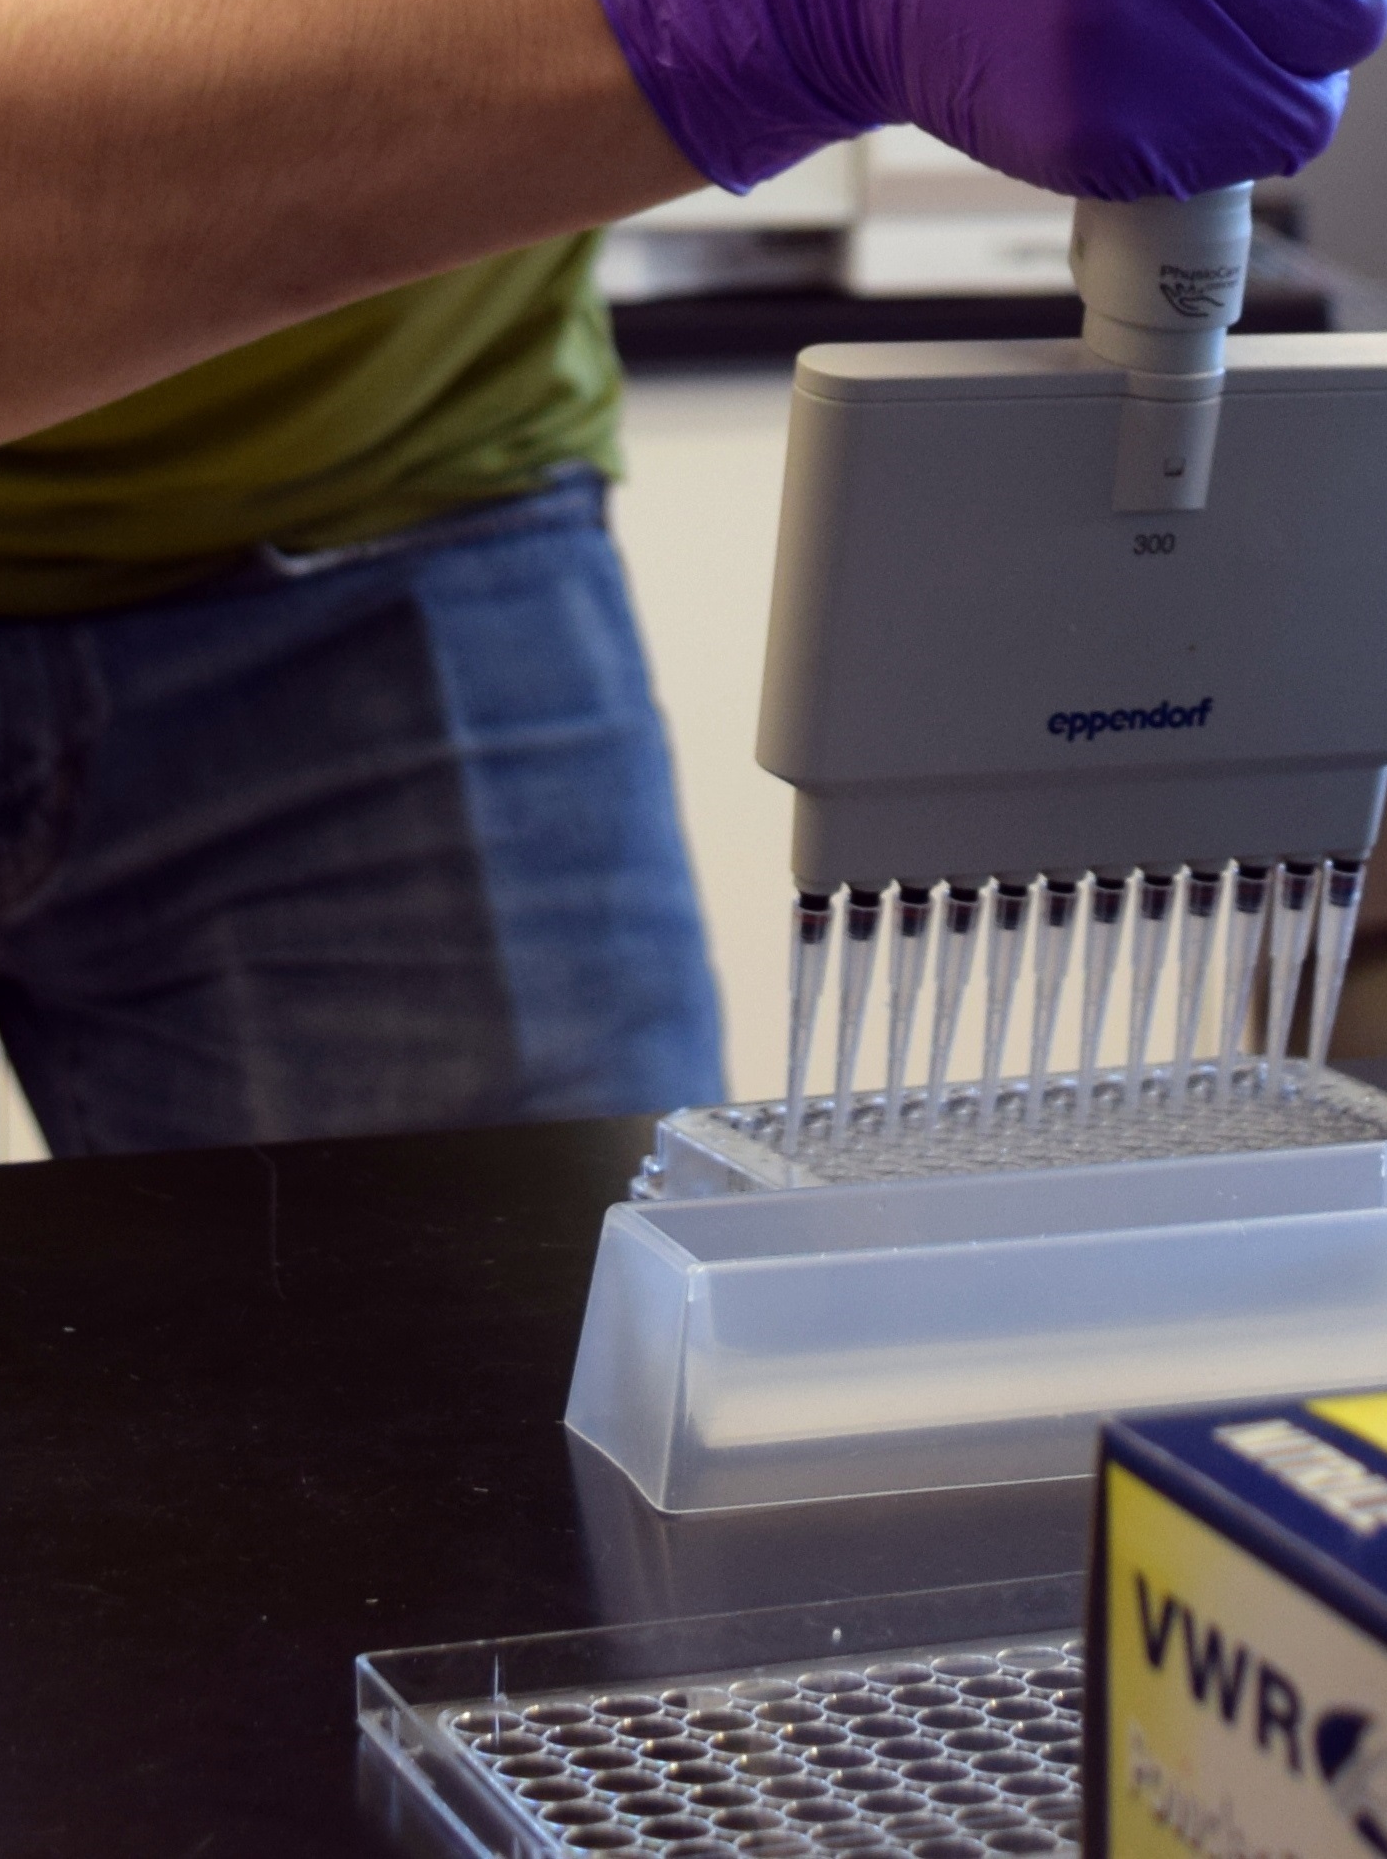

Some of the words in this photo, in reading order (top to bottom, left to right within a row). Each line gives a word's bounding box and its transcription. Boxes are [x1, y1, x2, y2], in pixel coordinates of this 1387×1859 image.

[1133, 533, 1176, 556] 300
[1047, 696, 1214, 743] eppendorf
[1134, 1571, 1303, 1781] VWR
